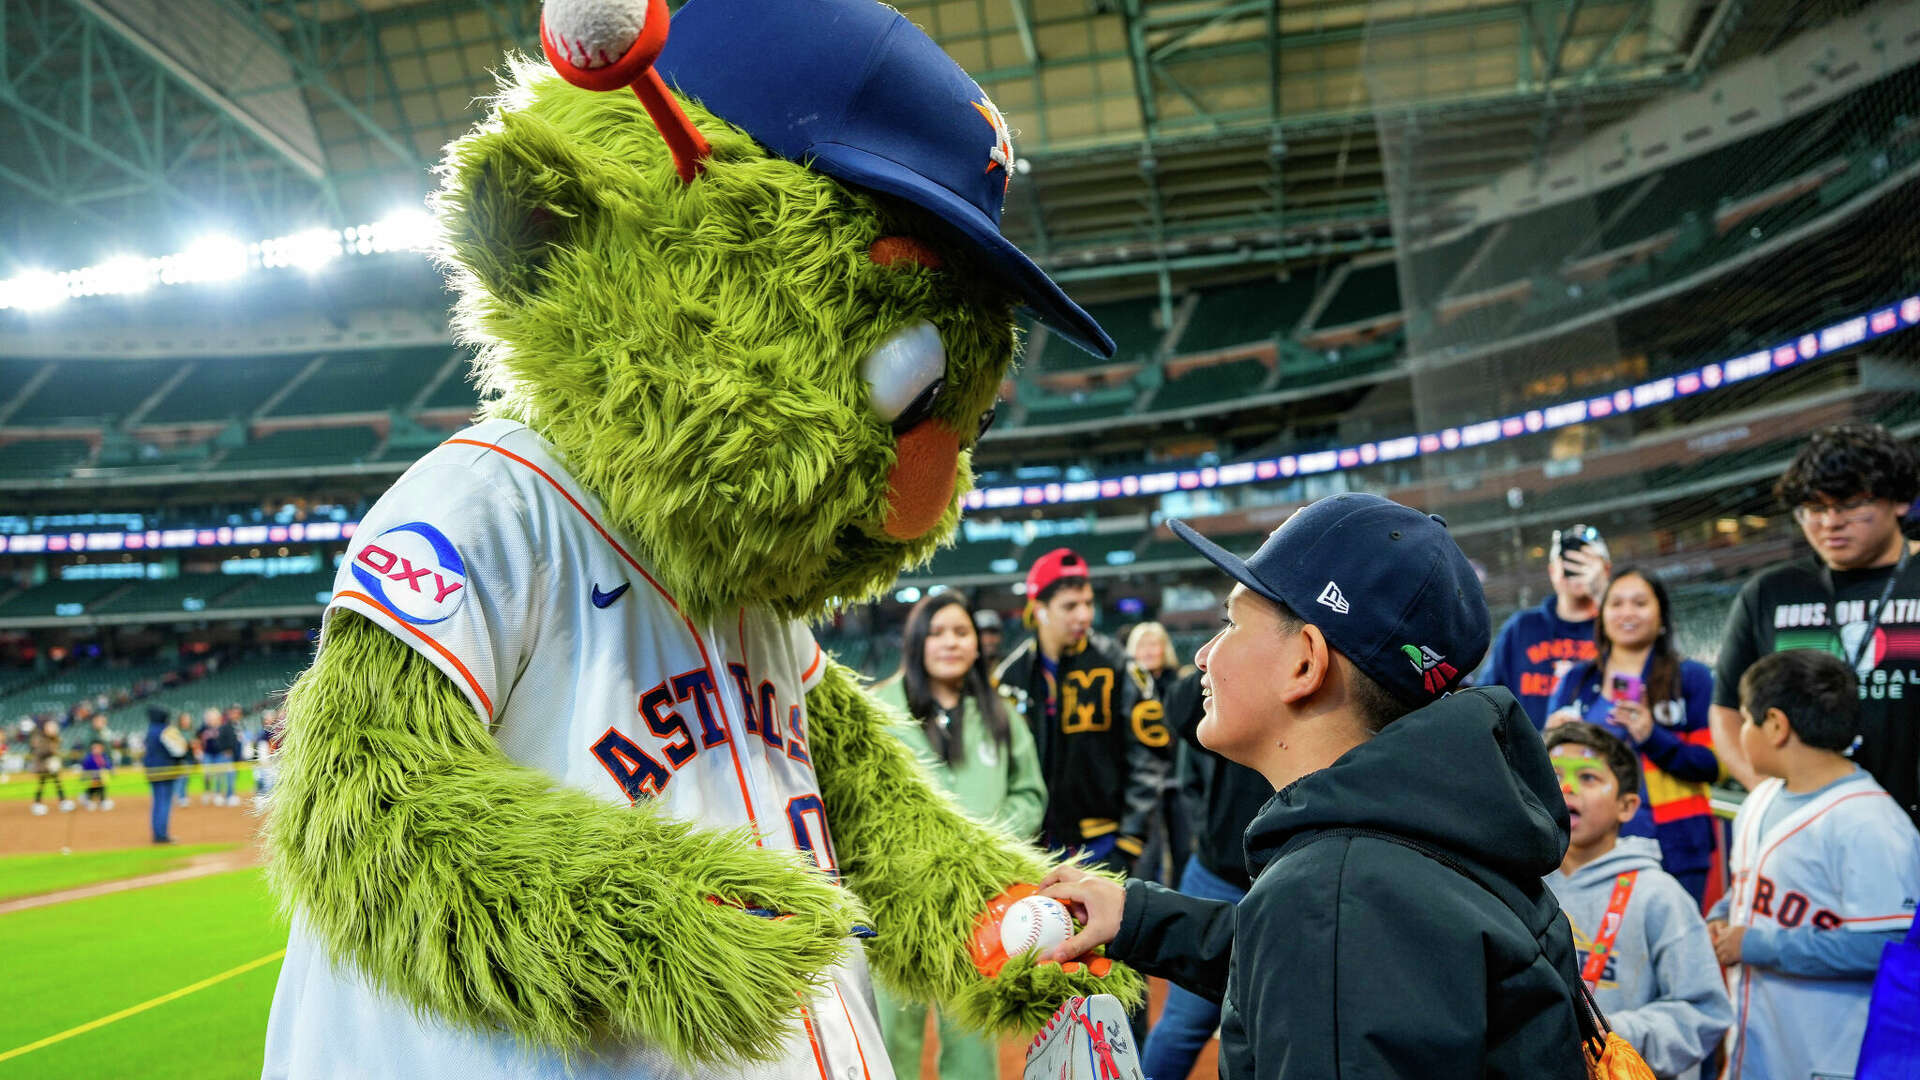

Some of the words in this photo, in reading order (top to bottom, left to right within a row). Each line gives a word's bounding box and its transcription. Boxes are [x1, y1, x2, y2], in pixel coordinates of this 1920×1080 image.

[358, 544, 463, 604] OXY
[1062, 667, 1114, 734] M
[589, 662, 813, 807] ASTROS
